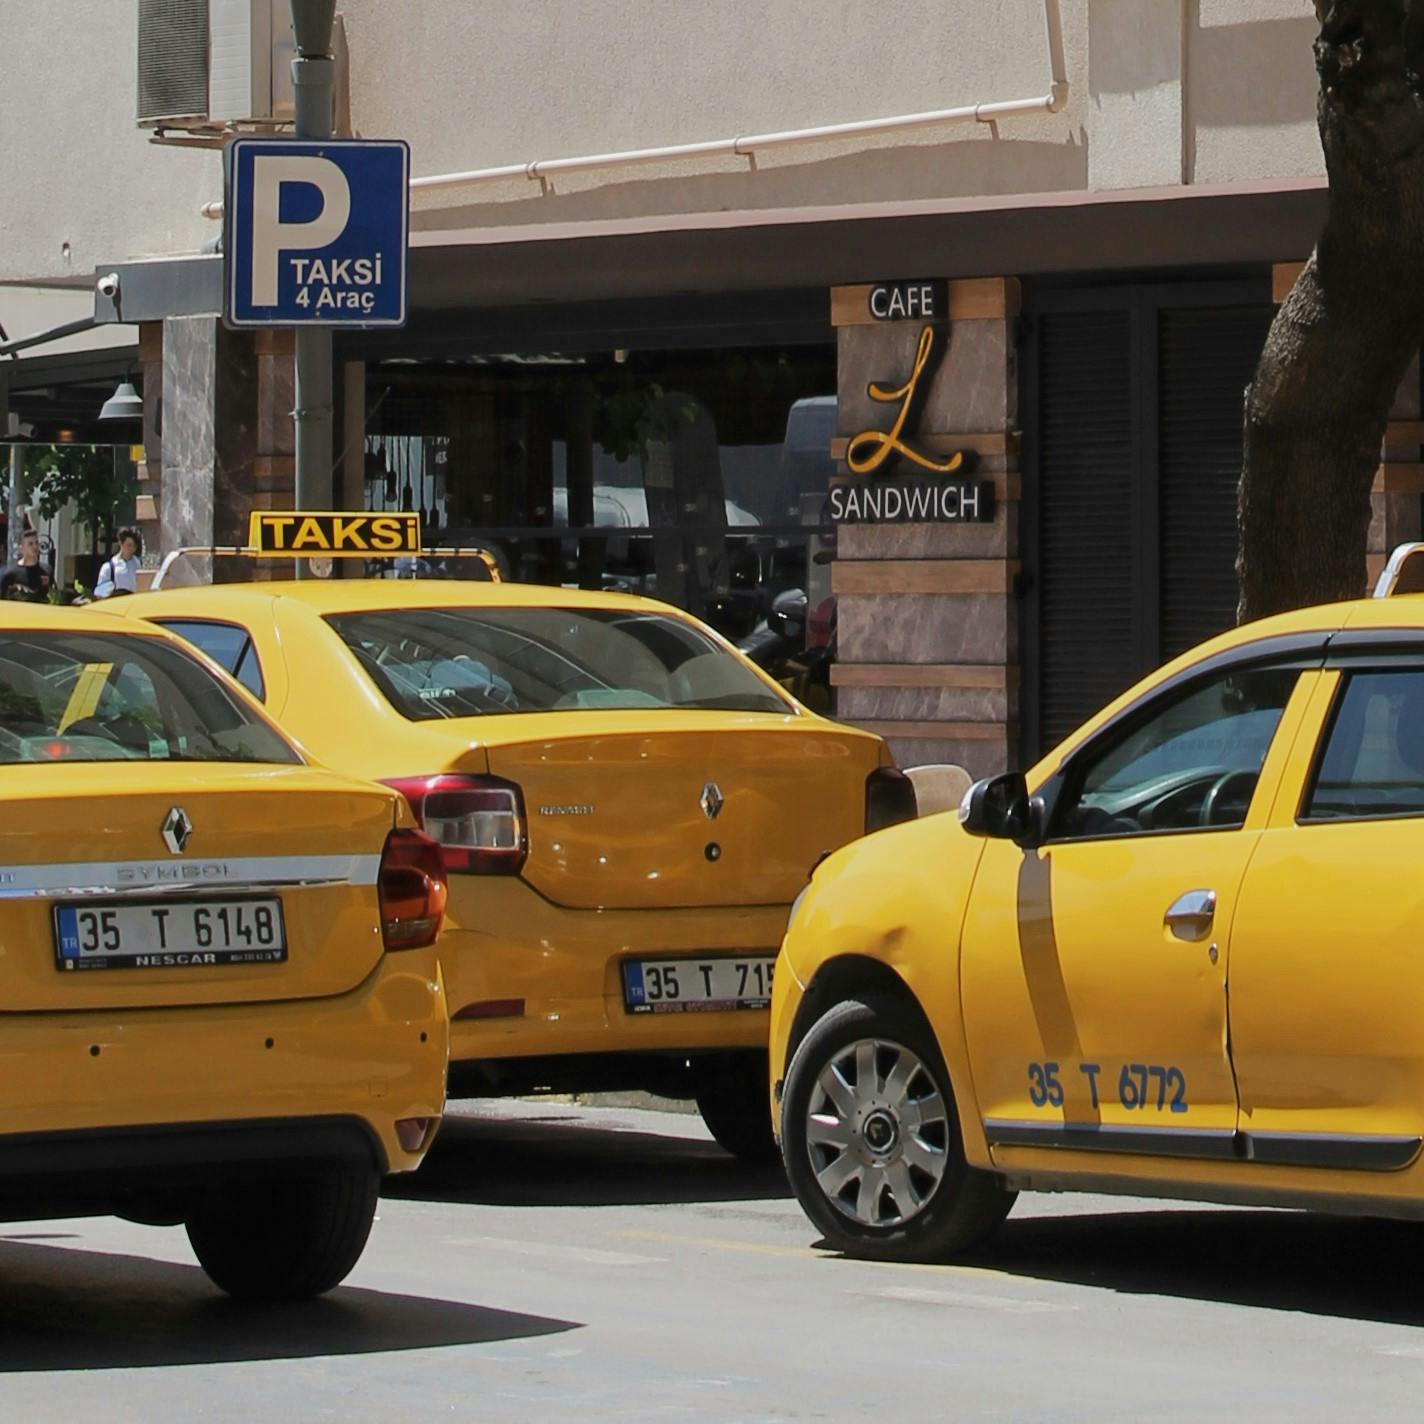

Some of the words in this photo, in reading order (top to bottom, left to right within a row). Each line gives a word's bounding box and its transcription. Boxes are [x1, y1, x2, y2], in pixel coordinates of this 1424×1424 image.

[251, 155, 351, 307] P
[290, 252, 381, 285] TAKSİ
[295, 287, 310, 308] 4
[316, 287, 375, 313] Araç
[871, 286, 933, 318] CAFE
[831, 485, 979, 520] SANDWICH
[62, 937, 78, 949] TR
[79, 912, 121, 951] 35
[152, 909, 170, 948] T
[193, 906, 274, 947] 6148
[136, 953, 217, 967] NESCAR
[646, 966, 680, 1000] 35
[699, 965, 713, 997] T
[1028, 1062, 1064, 1108] 35
[1079, 1064, 1101, 1110] T
[1118, 1064, 1189, 1113] 6772
